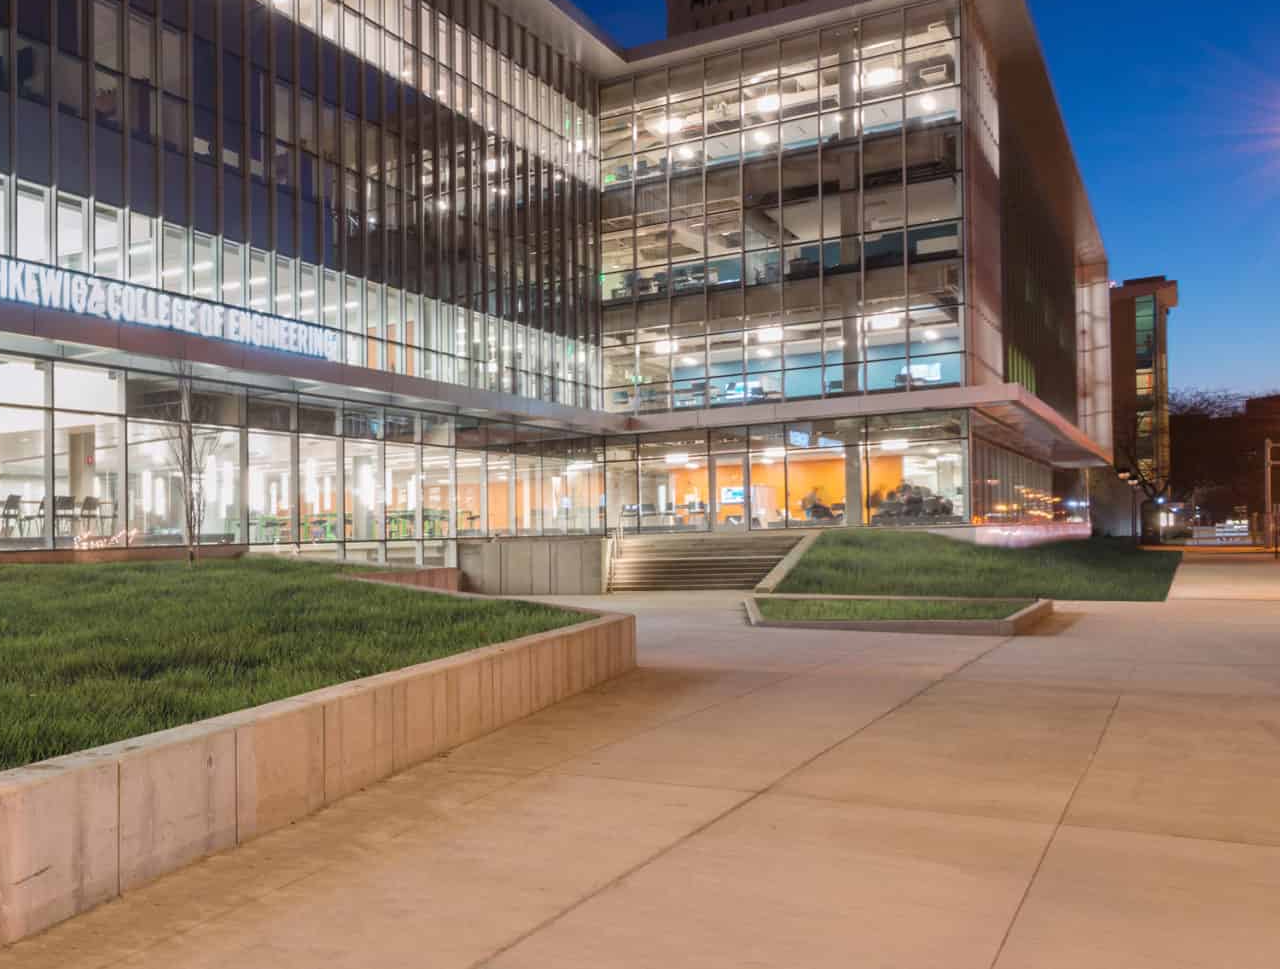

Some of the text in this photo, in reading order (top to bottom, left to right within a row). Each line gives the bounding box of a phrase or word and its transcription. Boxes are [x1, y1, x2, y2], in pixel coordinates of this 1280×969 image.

[107, 283, 200, 334] COLLEGE
[200, 302, 225, 337] OF
[227, 309, 336, 361] ENGINEERING
